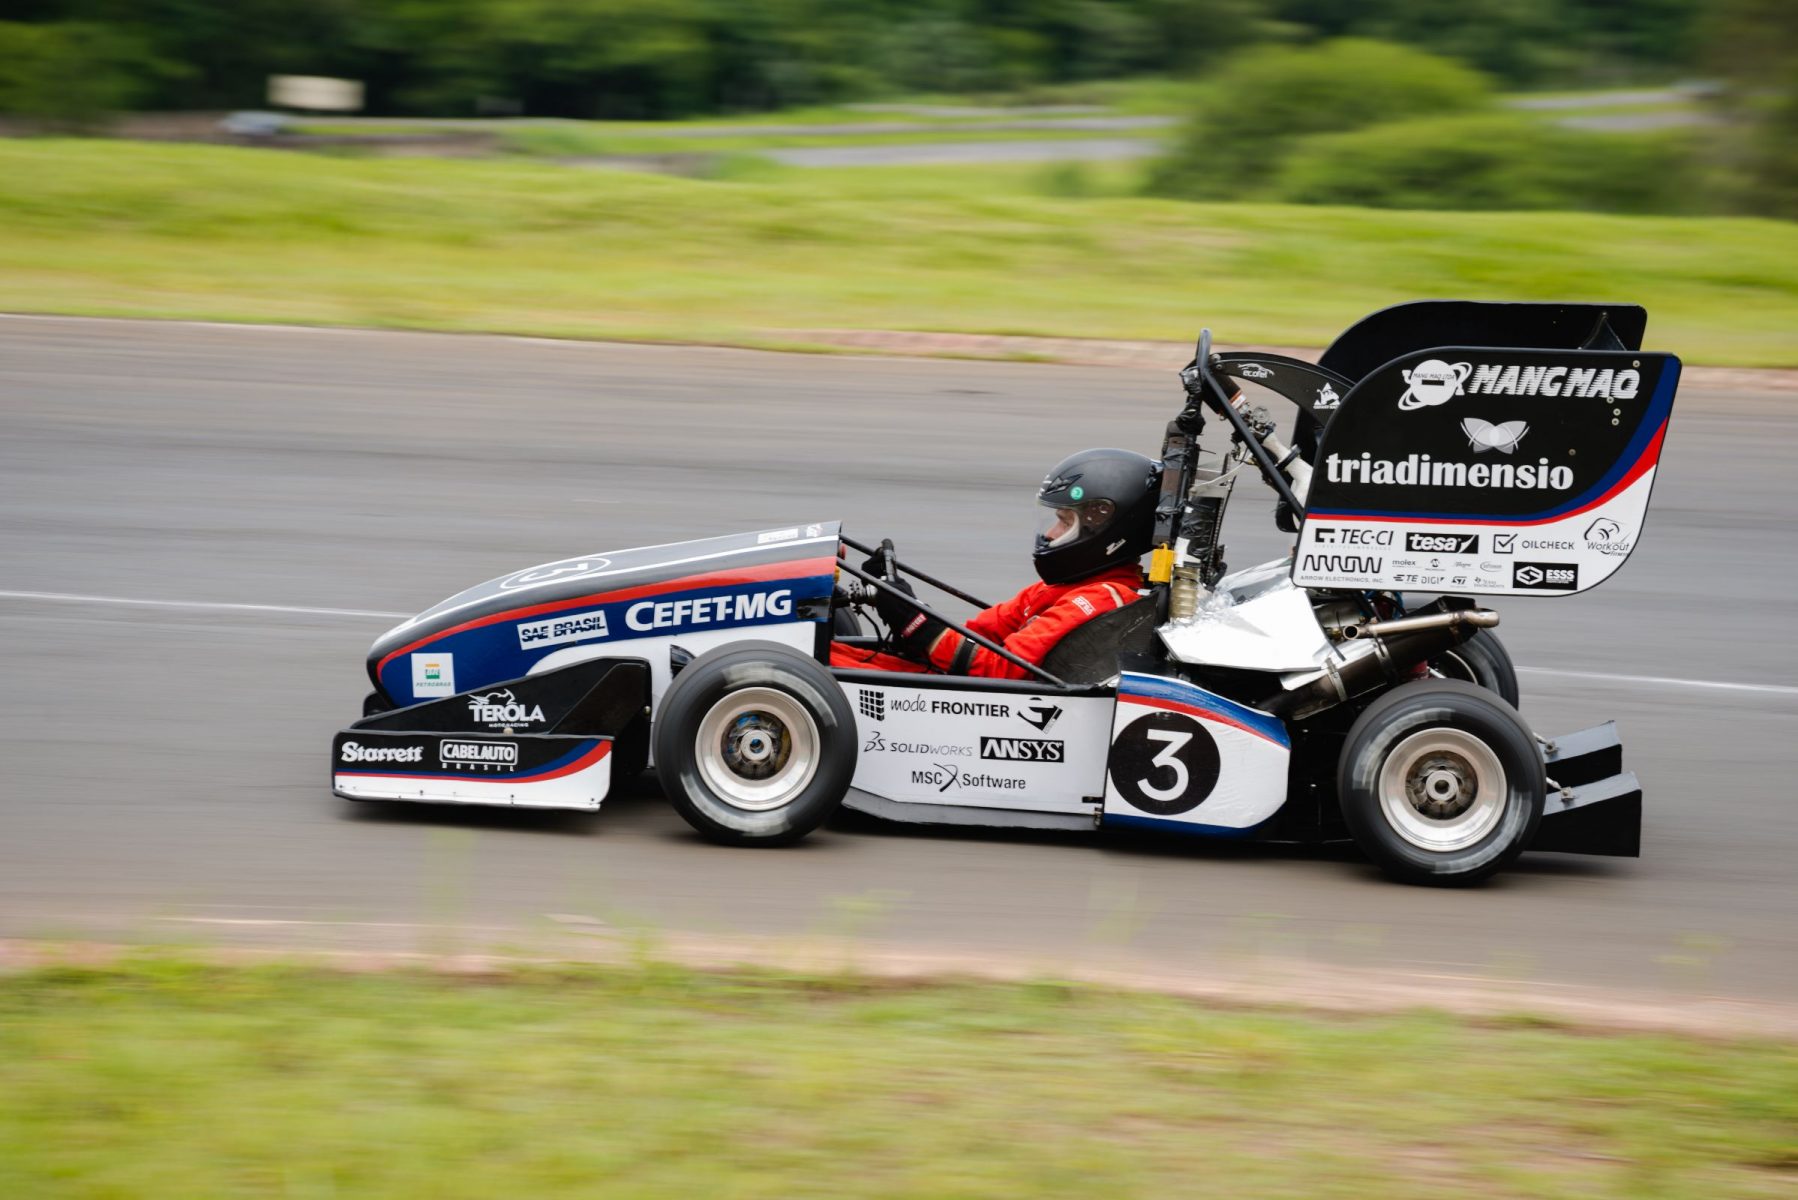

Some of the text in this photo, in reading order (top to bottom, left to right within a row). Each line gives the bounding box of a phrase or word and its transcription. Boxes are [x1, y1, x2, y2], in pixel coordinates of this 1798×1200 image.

[1326, 452, 1573, 490] triadimensio
[1409, 534, 1458, 551] tesa
[1522, 540, 1575, 550] OILCHECK
[1392, 559, 1416, 567] molex
[1546, 569, 1575, 582] ESSS
[625, 589, 792, 632] CEFET-MG
[521, 616, 606, 643] SAE BRASIL
[468, 704, 546, 722] TEROLA
[890, 694, 1010, 718] mode FRONTIER
[341, 740, 423, 763] Starrett
[442, 743, 515, 761] CABELAUTO
[890, 742, 973, 757] SOLIDWORKS
[982, 738, 1062, 761] ANSYS
[441, 762, 515, 772] BRASIL
[1137, 728, 1194, 802] 3
[911, 770, 1026, 790] MSC Software
